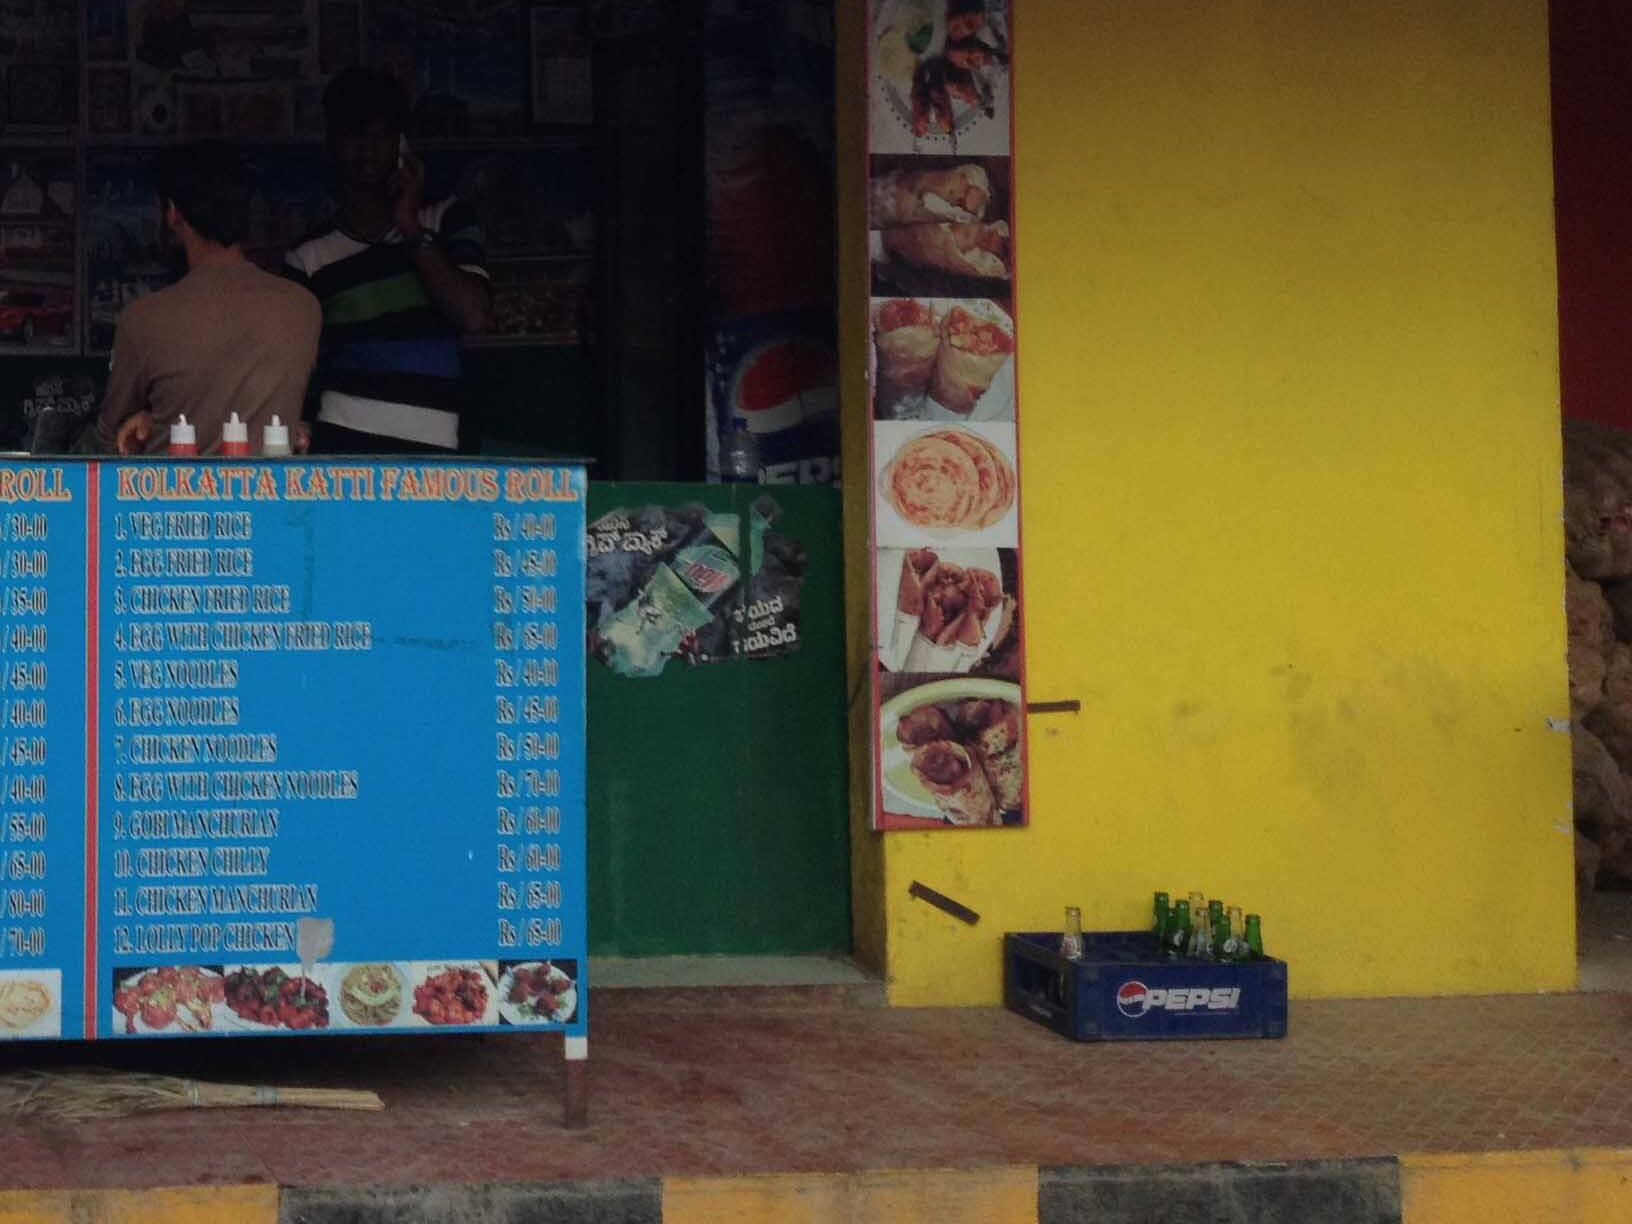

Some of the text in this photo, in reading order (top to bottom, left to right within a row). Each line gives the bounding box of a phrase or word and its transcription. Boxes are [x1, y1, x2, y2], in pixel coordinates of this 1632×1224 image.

[116, 467, 580, 502] KOLKATTA KATTI FAMOUS ROLL
[1142, 988, 1241, 1010] PEPSI
